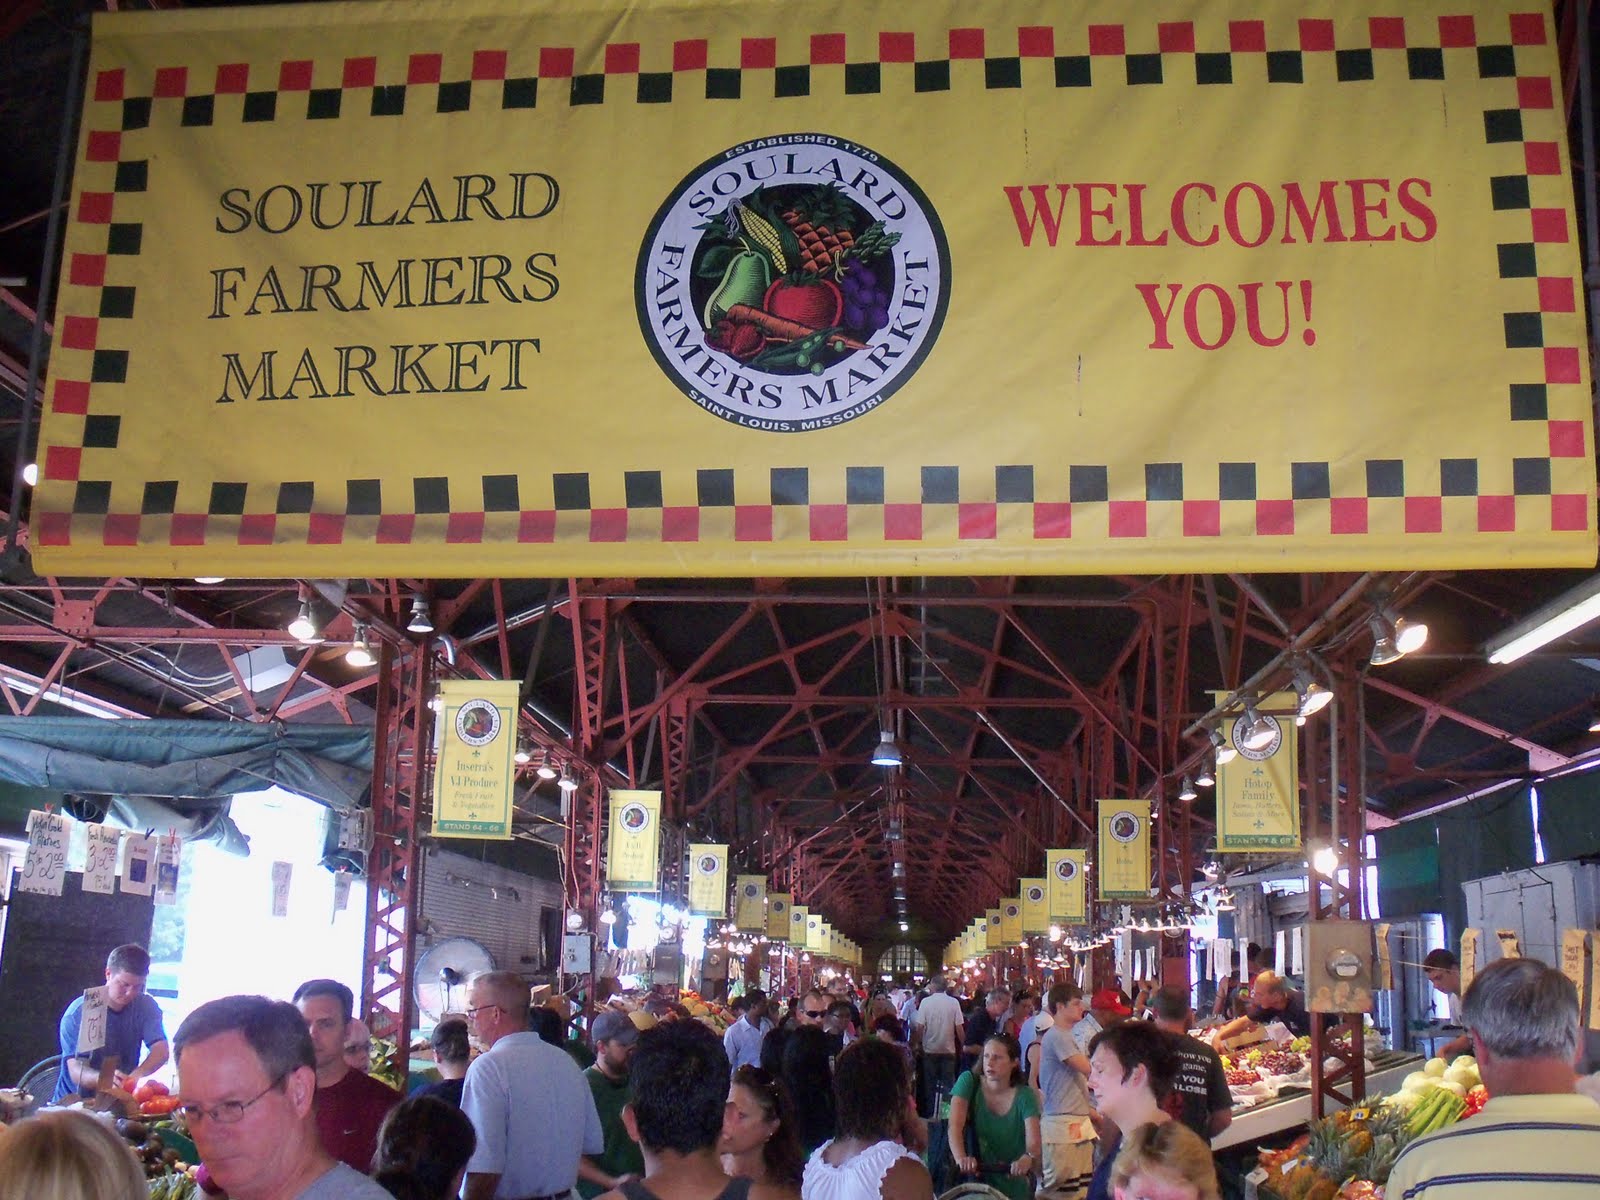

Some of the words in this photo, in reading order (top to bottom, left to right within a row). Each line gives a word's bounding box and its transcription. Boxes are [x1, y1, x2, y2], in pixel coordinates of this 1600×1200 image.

[724, 134, 838, 160] ESTABLISHED
[843, 143, 880, 163] 1779
[215, 172, 560, 234] SOULARD
[689, 153, 907, 221] SOULARD
[1003, 178, 1438, 248] WELCOMES
[207, 252, 560, 319] FARMERS
[656, 241, 783, 410] FARMERS
[797, 251, 930, 410] MARKET
[1135, 279, 1317, 350] YOU!
[215, 338, 541, 404] MARKET
[688, 389, 735, 421] SAINT
[801, 394, 884, 432] MISSOURI
[457, 760, 494, 772] Inserra's
[464, 776, 499, 788] Produce
[1241, 791, 1275, 801] Family
[444, 823, 471, 831] STAND
[1182, 1075, 1205, 1084] YOU
